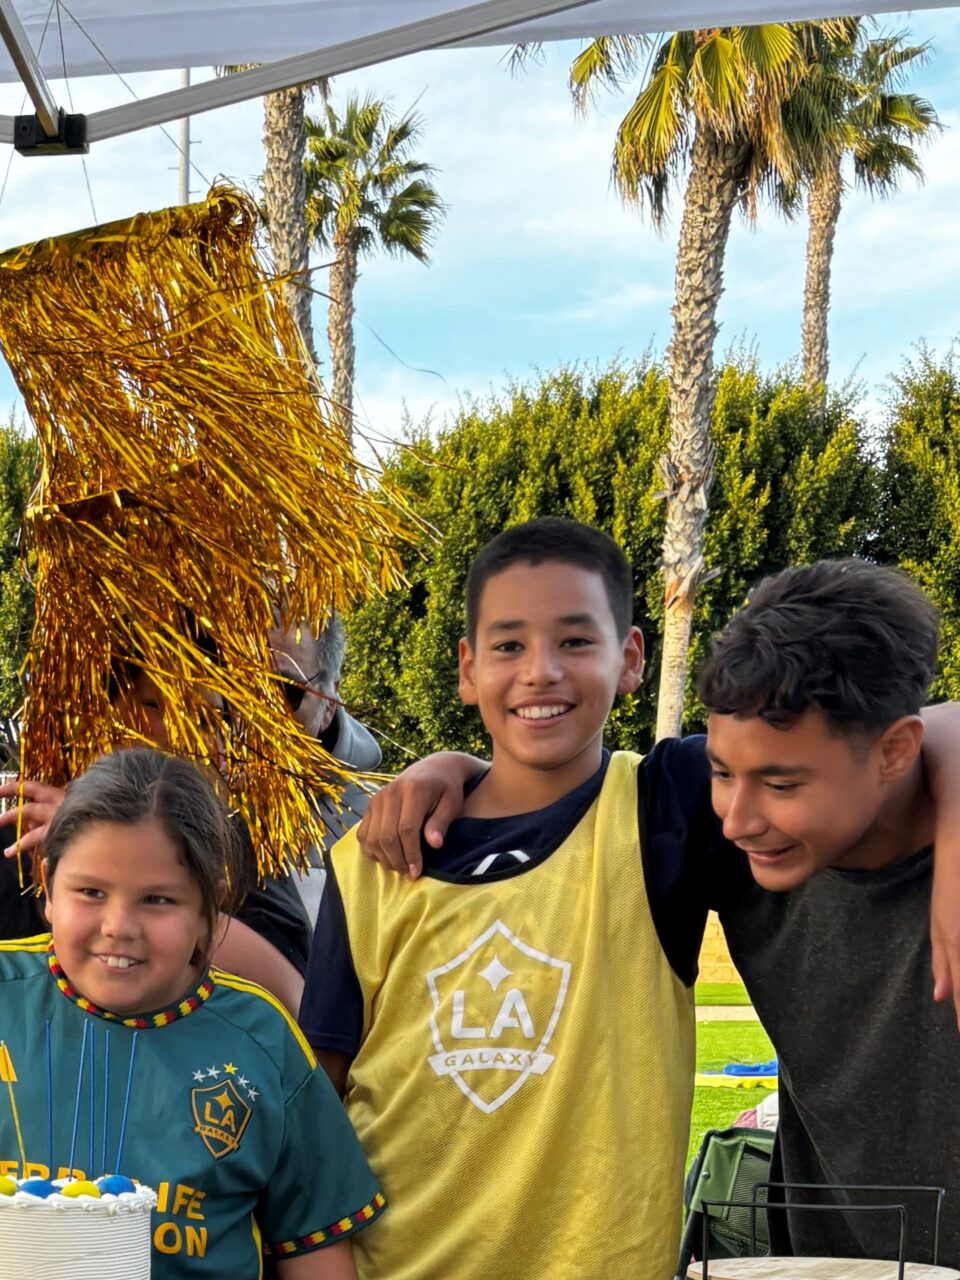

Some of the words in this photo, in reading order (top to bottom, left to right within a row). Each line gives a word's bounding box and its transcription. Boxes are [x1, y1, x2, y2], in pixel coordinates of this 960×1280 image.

[451, 988, 535, 1039] LA
[443, 1051, 539, 1069] GALAXY
[204, 1102, 236, 1133] LA
